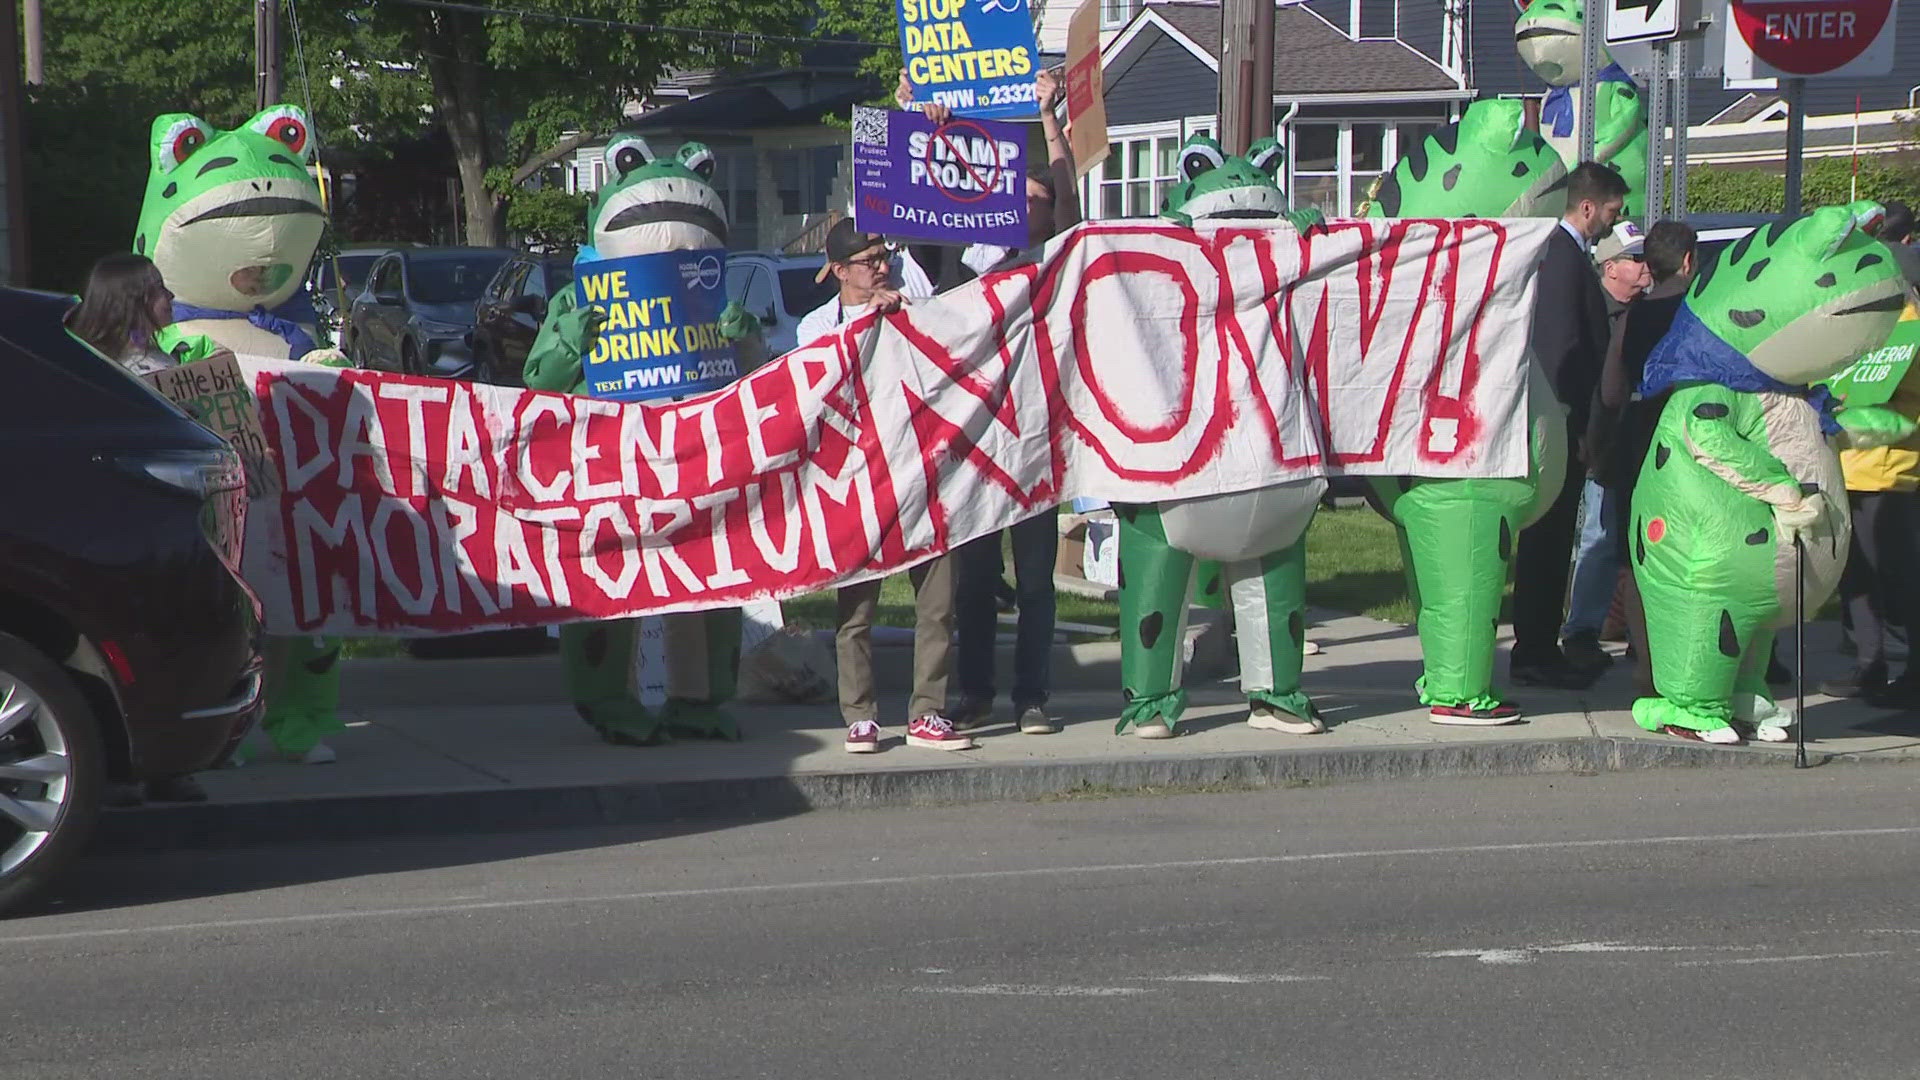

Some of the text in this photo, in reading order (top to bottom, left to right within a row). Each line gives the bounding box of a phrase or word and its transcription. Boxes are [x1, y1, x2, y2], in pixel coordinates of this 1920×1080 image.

[902, 0, 966, 22] STOP
[1765, 11, 1857, 40] ENTER
[905, 21, 972, 54] DATA
[909, 46, 1031, 85] CENTERS
[932, 89, 974, 108] FWW
[908, 131, 1020, 168] STAMP
[910, 159, 1017, 195] PROJECT
[864, 194, 1020, 229] NO DATA CENTERS!
[581, 270, 629, 302] WE
[589, 327, 681, 365] DRINK
[1862, 343, 1914, 365] SIERRA
[208, 361, 239, 391] bit
[595, 358, 737, 393] TEXT FWW TO 23321
[1853, 364, 1892, 383] CLUB
[850, 217, 1507, 567] NOW!
[270, 343, 864, 502] DATA CENTER
[290, 438, 884, 622] MORATORIUM
